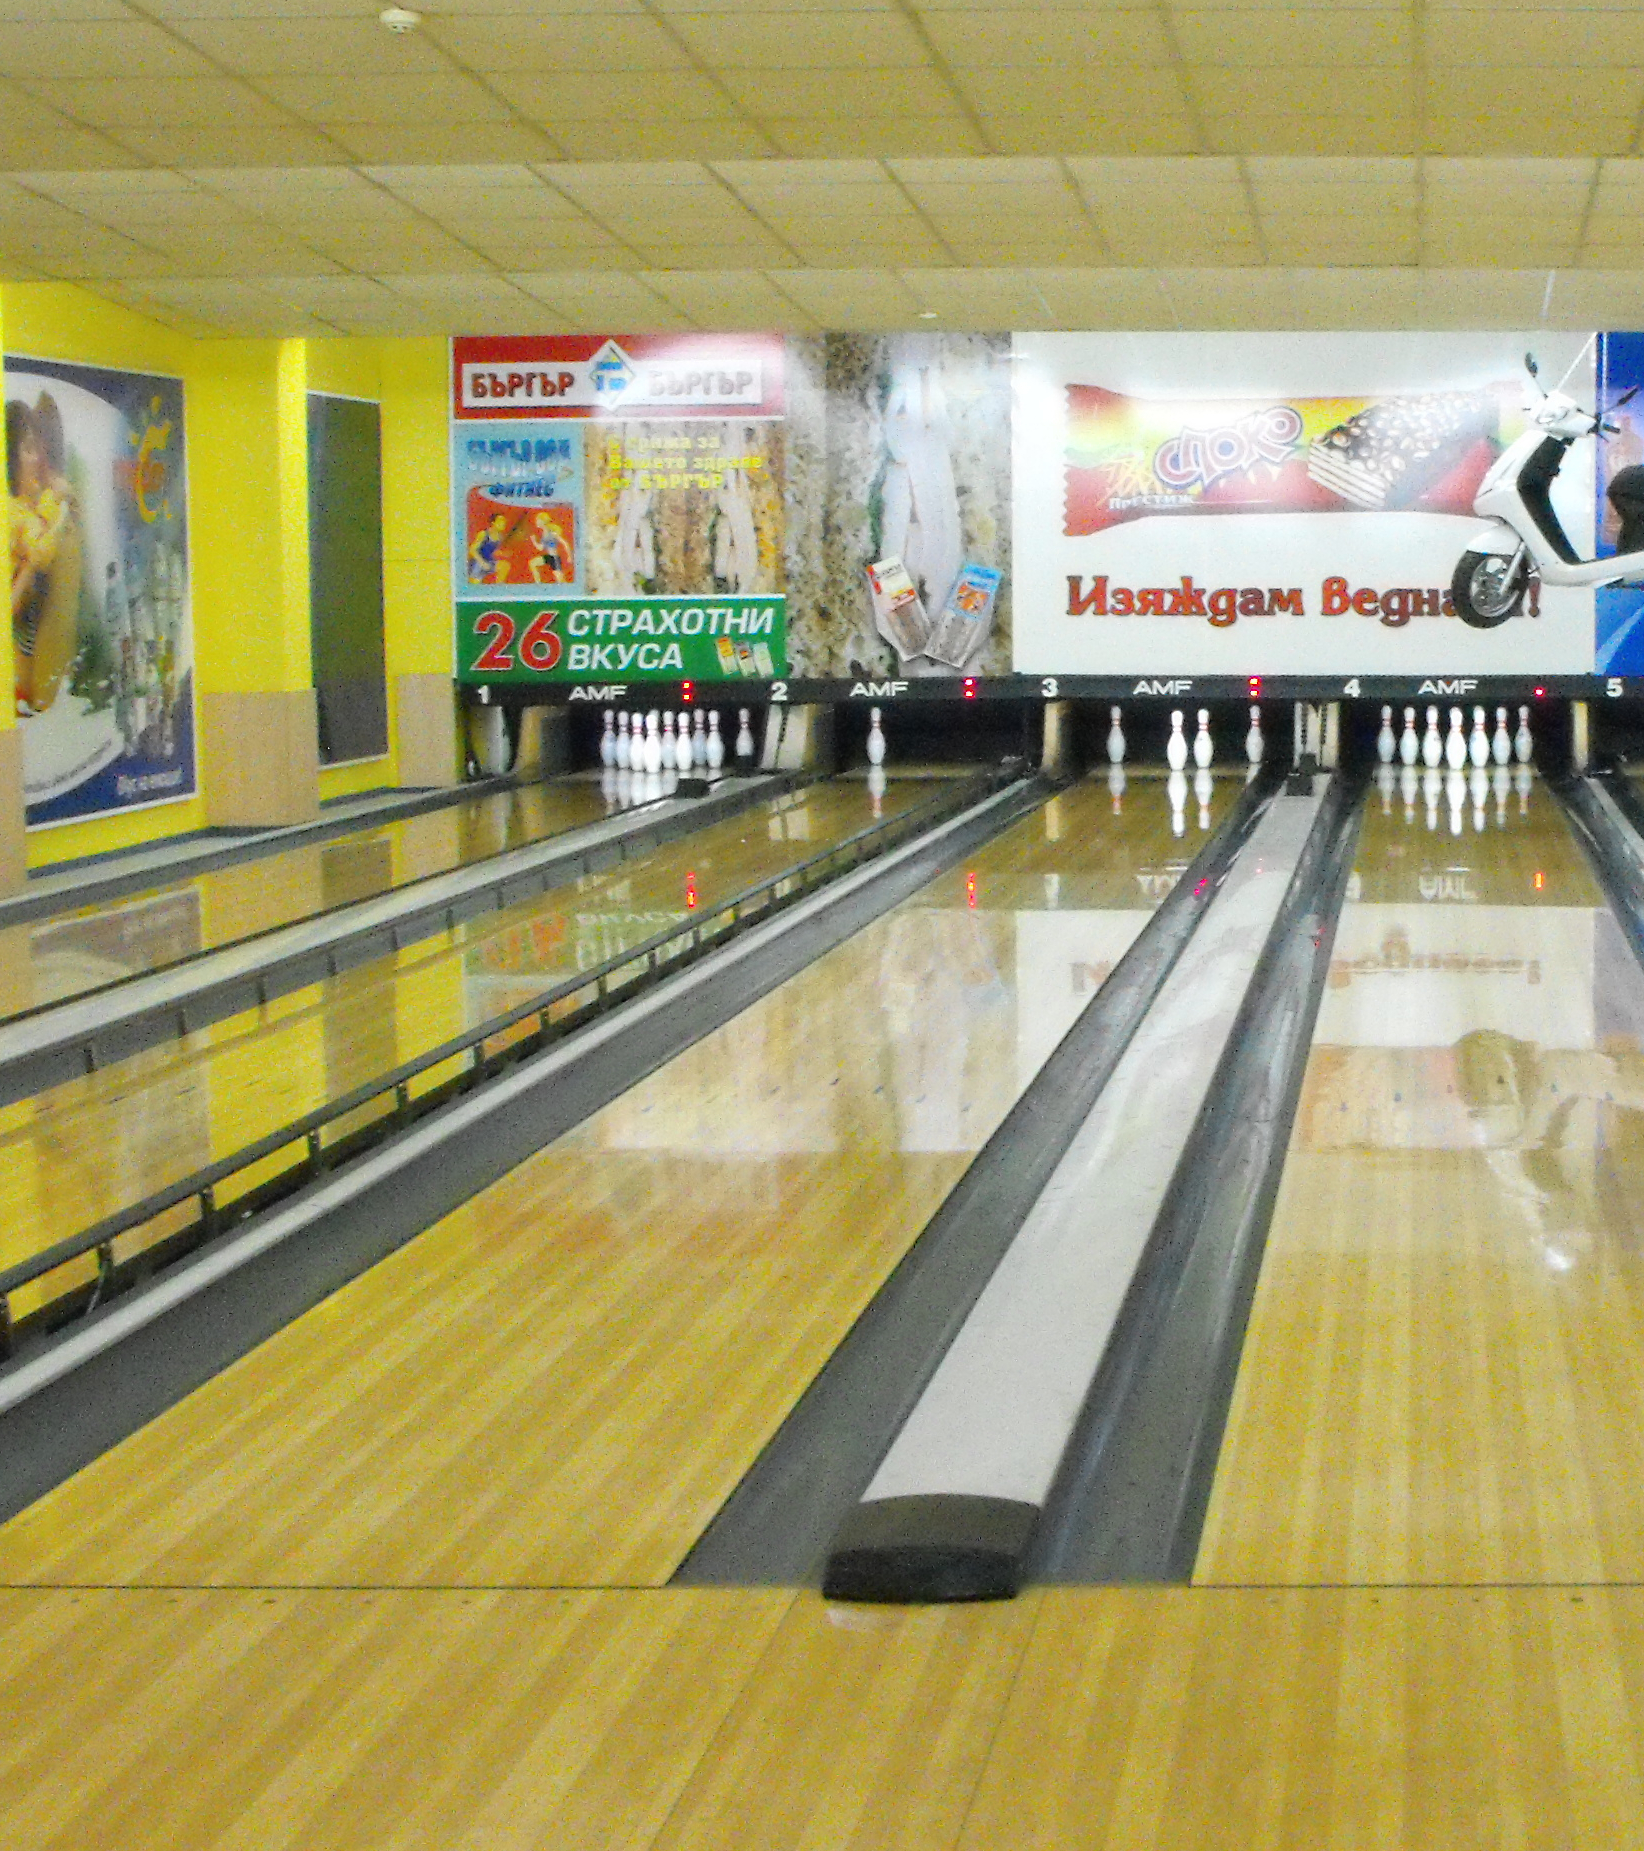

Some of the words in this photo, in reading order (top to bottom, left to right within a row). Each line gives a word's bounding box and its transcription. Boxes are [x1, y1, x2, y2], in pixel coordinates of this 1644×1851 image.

[471, 372, 574, 398] БЪРГЪР
[650, 370, 753, 397] БЪРГЪР
[1066, 575, 1304, 627] Изяждам
[1321, 576, 1541, 628] Ведна!
[568, 608, 774, 636] СТРАХОТНИ
[470, 611, 562, 671] 26
[568, 643, 683, 671] ВКУСА
[477, 685, 489, 704] 1
[568, 685, 628, 701] AMF
[771, 682, 788, 700] 2
[850, 681, 909, 698] AMF
[1041, 679, 1059, 698] 3
[1132, 680, 1194, 695] AMF
[1344, 679, 1361, 698] 4
[1418, 679, 1479, 695] AMF
[1606, 679, 1624, 698] 5
